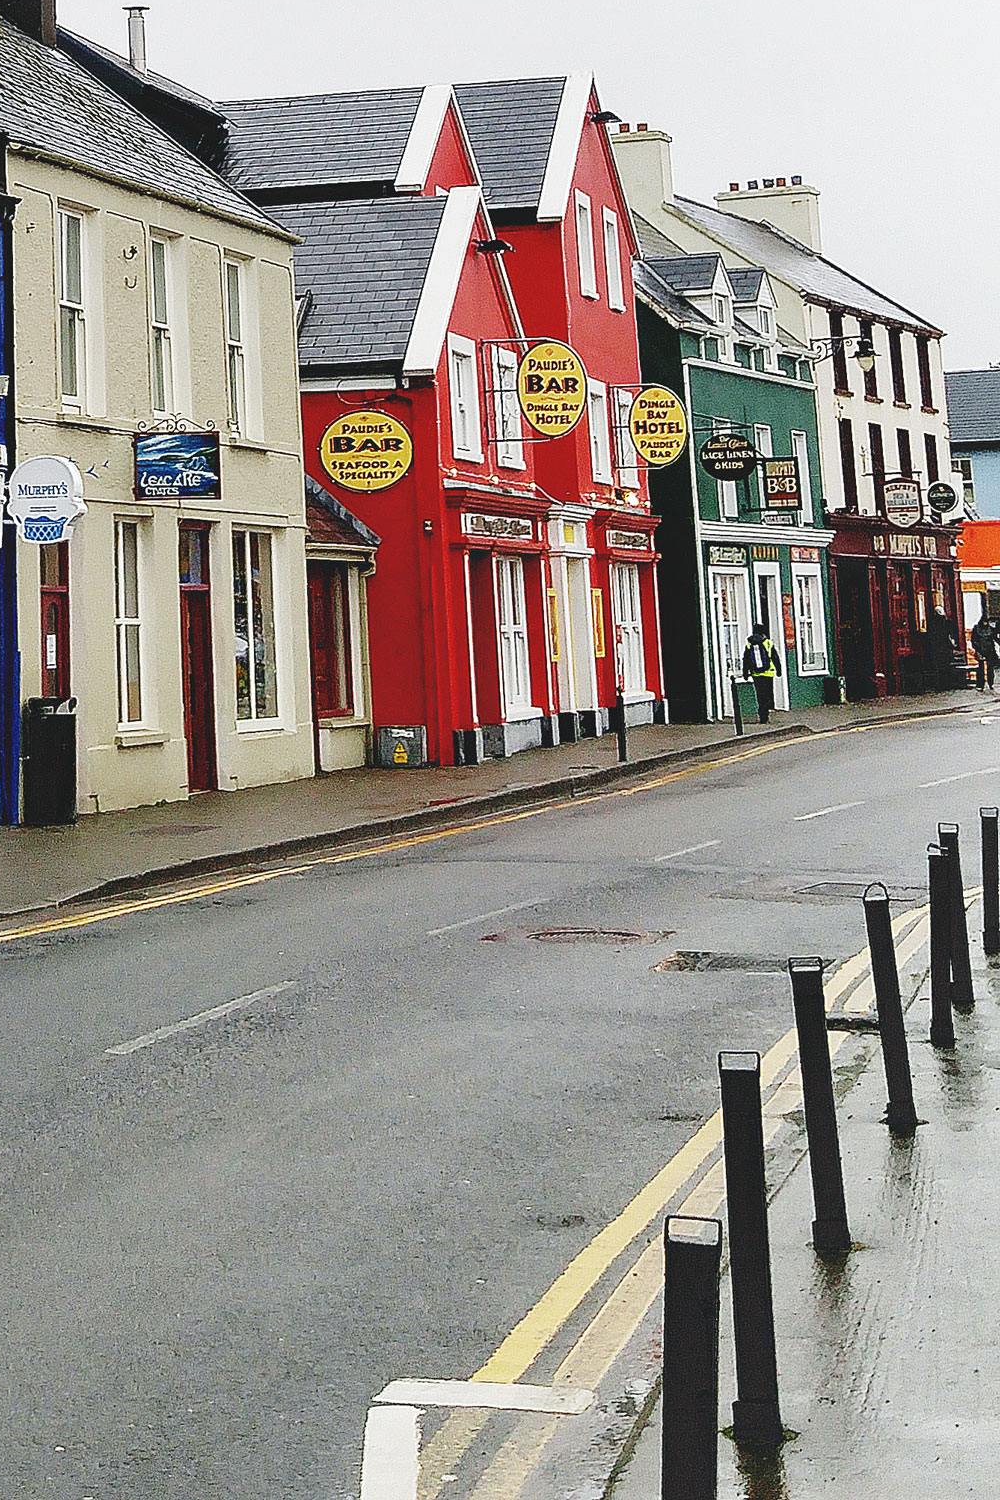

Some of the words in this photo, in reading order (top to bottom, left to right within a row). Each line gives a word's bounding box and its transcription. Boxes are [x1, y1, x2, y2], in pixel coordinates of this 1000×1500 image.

[528, 358, 575, 372] PAUDIE'S
[524, 373, 580, 394] BAR
[527, 403, 558, 412] DINGLE
[561, 403, 580, 412] BAY
[639, 399, 676, 409] DINGLE
[536, 413, 572, 425] HOTEL
[647, 410, 668, 420] BAY
[341, 422, 393, 435] PAUDIE'S
[634, 420, 683, 435] HOTEL
[329, 436, 404, 454] BAR
[640, 439, 681, 449] PAUDIE'S
[650, 450, 672, 458] BAR
[331, 461, 389, 470] SEAFOOD
[393, 460, 404, 469] A
[721, 460, 744, 469] KIDS
[339, 470, 397, 480] SPECIALITY
[17, 481, 68, 497] MURPHY'S
[767, 477, 798, 494] B&B
